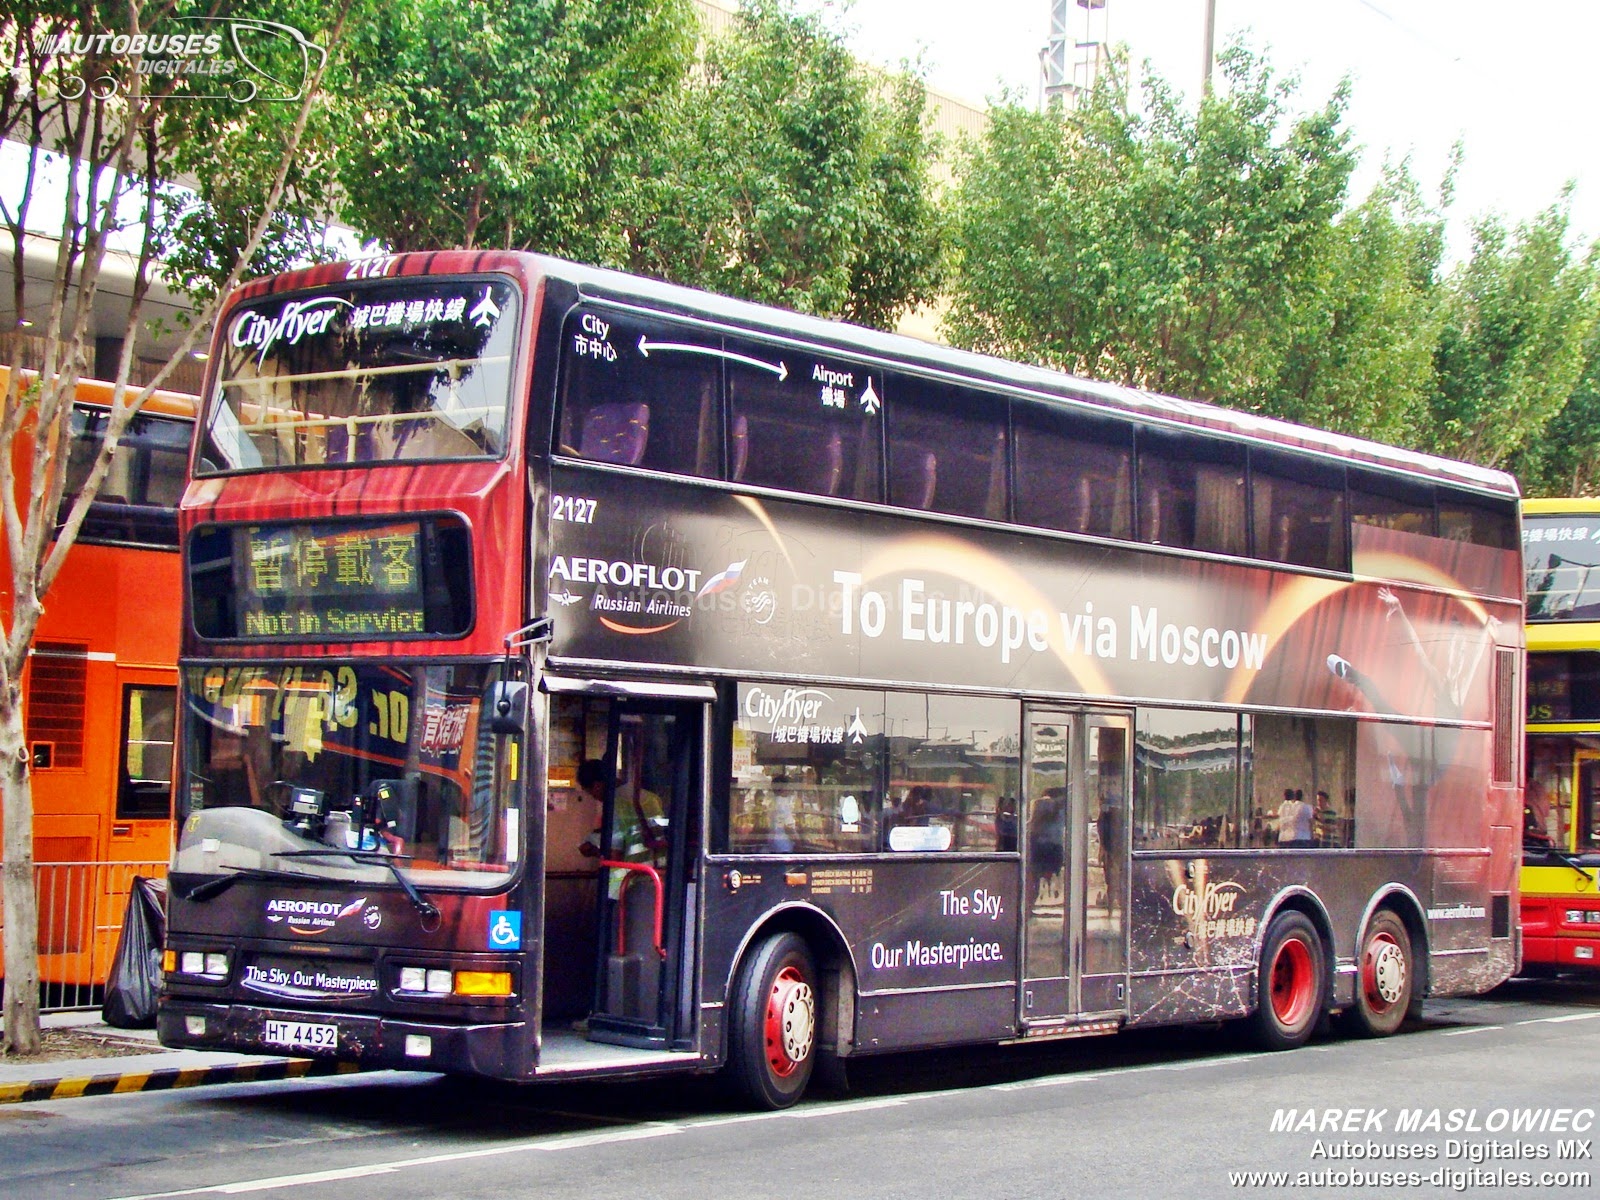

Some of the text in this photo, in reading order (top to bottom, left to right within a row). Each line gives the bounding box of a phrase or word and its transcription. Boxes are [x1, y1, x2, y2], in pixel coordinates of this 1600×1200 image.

[345, 256, 398, 279] 2127
[351, 297, 467, 329] 城巴機場快線
[582, 313, 610, 340] City
[574, 333, 618, 362] 市中心
[812, 363, 854, 387] Airport
[821, 386, 846, 409] 機場
[552, 495, 598, 524] 2127
[250, 535, 416, 590] 暫停載客
[548, 556, 702, 592] AEROFLOT
[594, 594, 692, 617] Russian Airlines
[246, 607, 425, 635] Not in Service
[833, 570, 1268, 670] To Europe via Moscow
[775, 724, 844, 745] 城巴機場快線
[267, 899, 342, 916] AEROFLOT
[940, 889, 1004, 920] The Sky.
[871, 939, 1004, 969] Our Masterpiece.
[246, 965, 378, 992] The Sky. Our Masterpiece.
[269, 1023, 335, 1045] HT 4452
